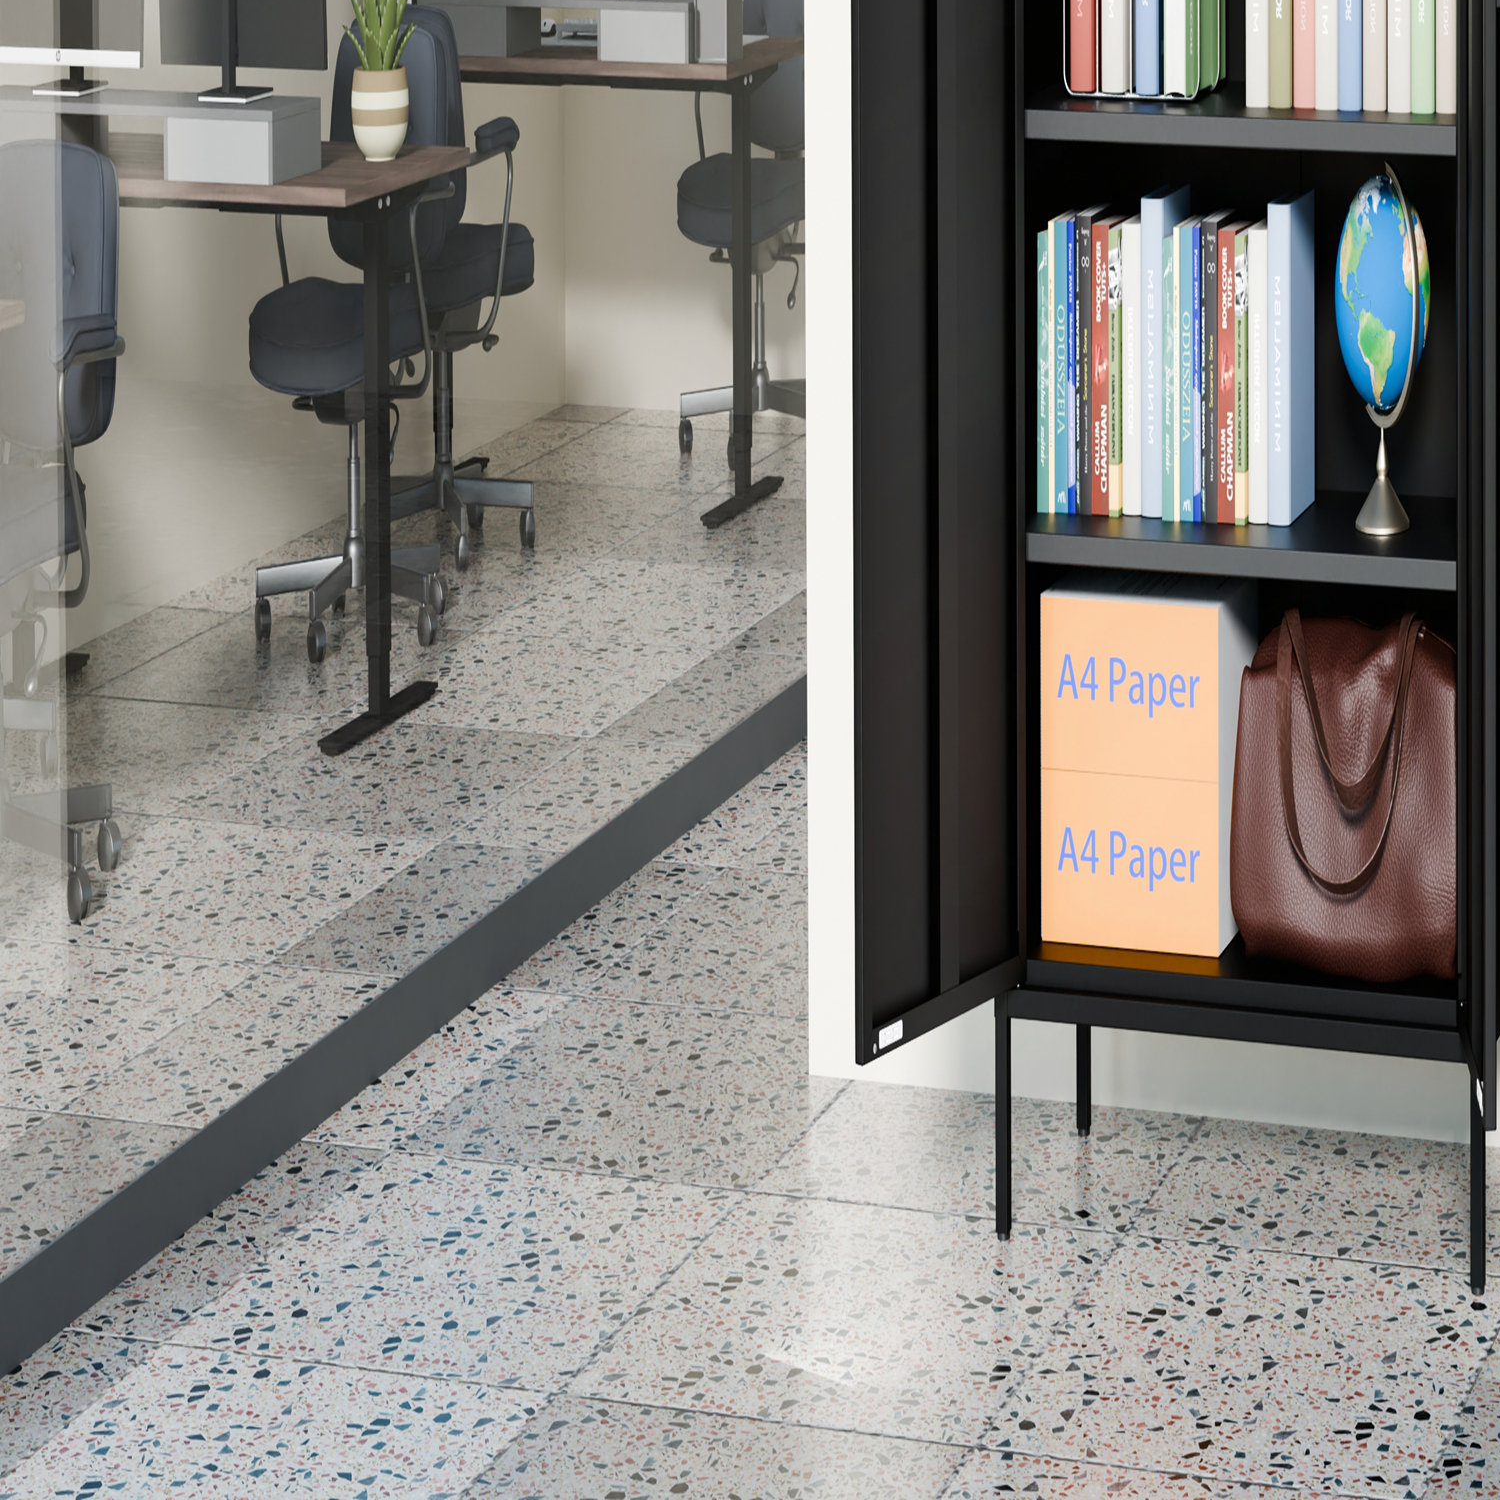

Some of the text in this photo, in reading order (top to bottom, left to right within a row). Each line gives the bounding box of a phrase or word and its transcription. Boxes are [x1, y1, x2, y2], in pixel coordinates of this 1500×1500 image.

[1100, 405, 1108, 493] CHAPMAN
[1226, 412, 1234, 501] CHAPMAN
[1057, 653, 1201, 718] A4 Paper
[1057, 827, 1201, 892] A4 Paper
